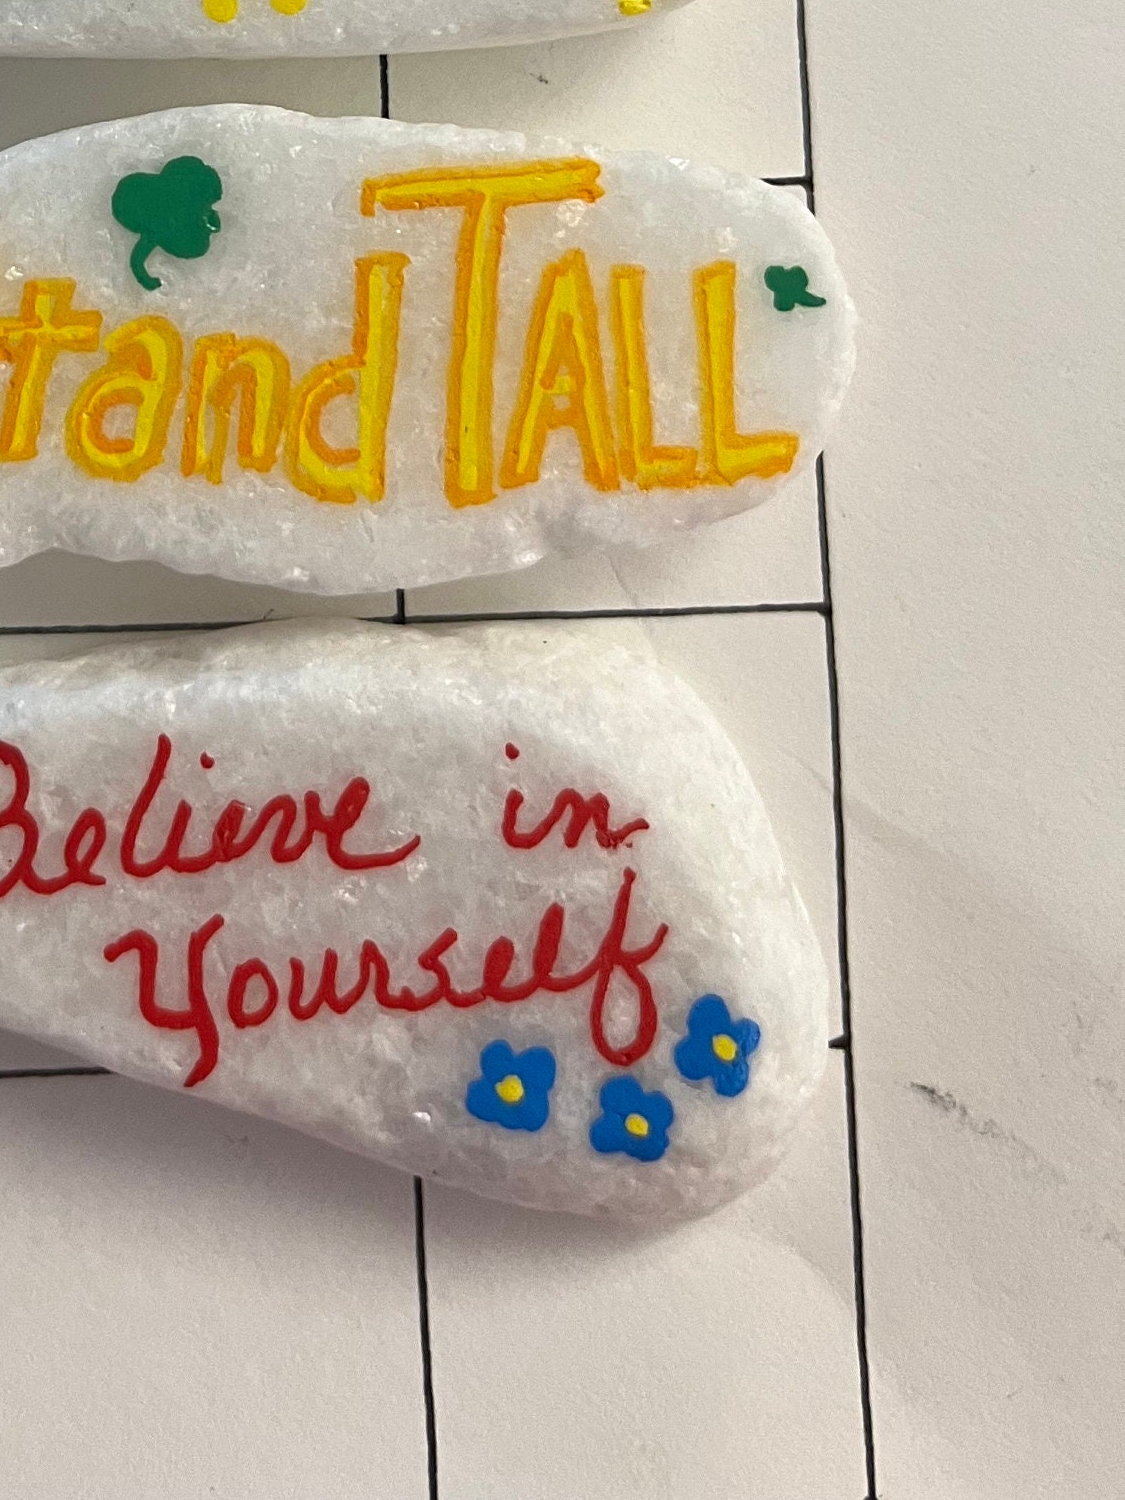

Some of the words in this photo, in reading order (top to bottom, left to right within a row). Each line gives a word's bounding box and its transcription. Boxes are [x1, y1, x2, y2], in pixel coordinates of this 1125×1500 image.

[361, 157, 799, 508] TALL
[502, 742, 649, 850] in
[103, 868, 669, 1087] Yourself
